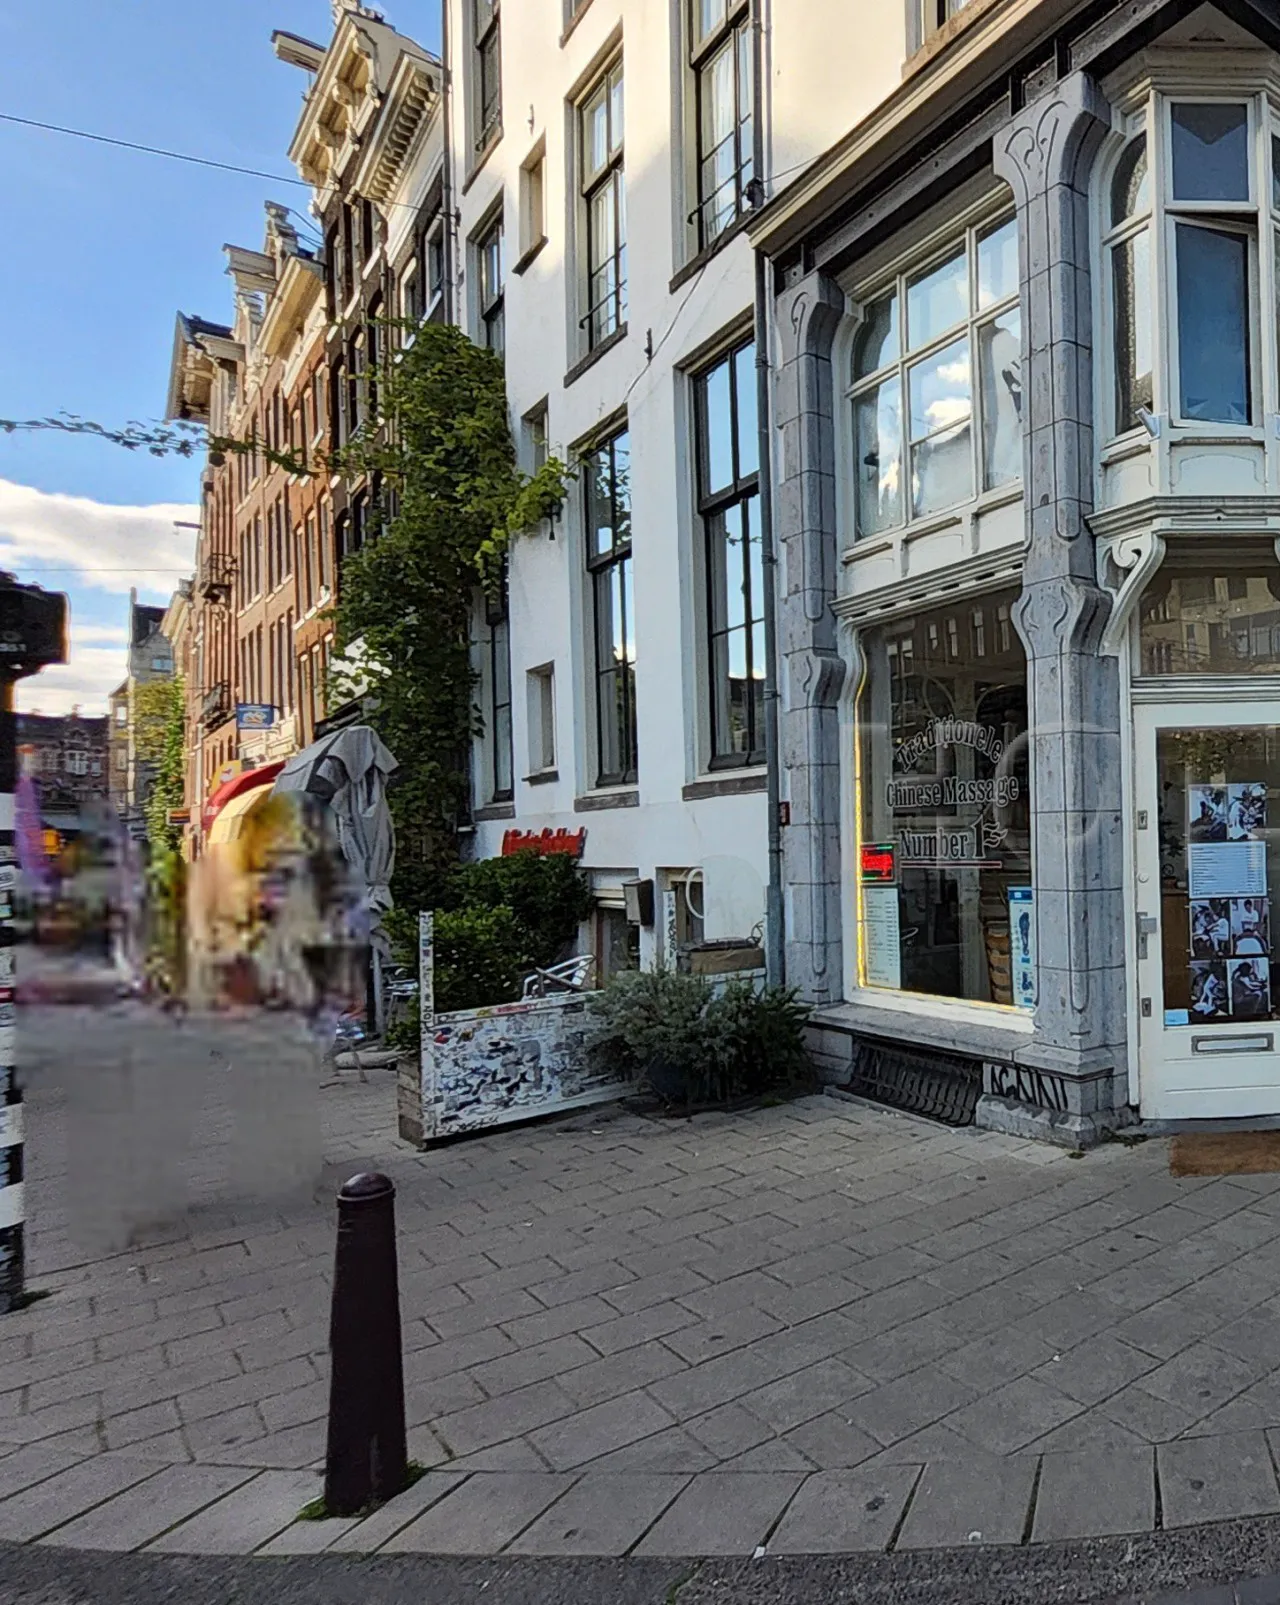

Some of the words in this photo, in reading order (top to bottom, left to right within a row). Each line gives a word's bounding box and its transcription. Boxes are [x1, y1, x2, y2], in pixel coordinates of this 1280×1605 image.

[896, 714, 1004, 772] Traditionele
[886, 781, 941, 807] Chinese
[943, 776, 1018, 807] Massage
[900, 827, 969, 860] Number
[971, 814, 987, 859] 1
